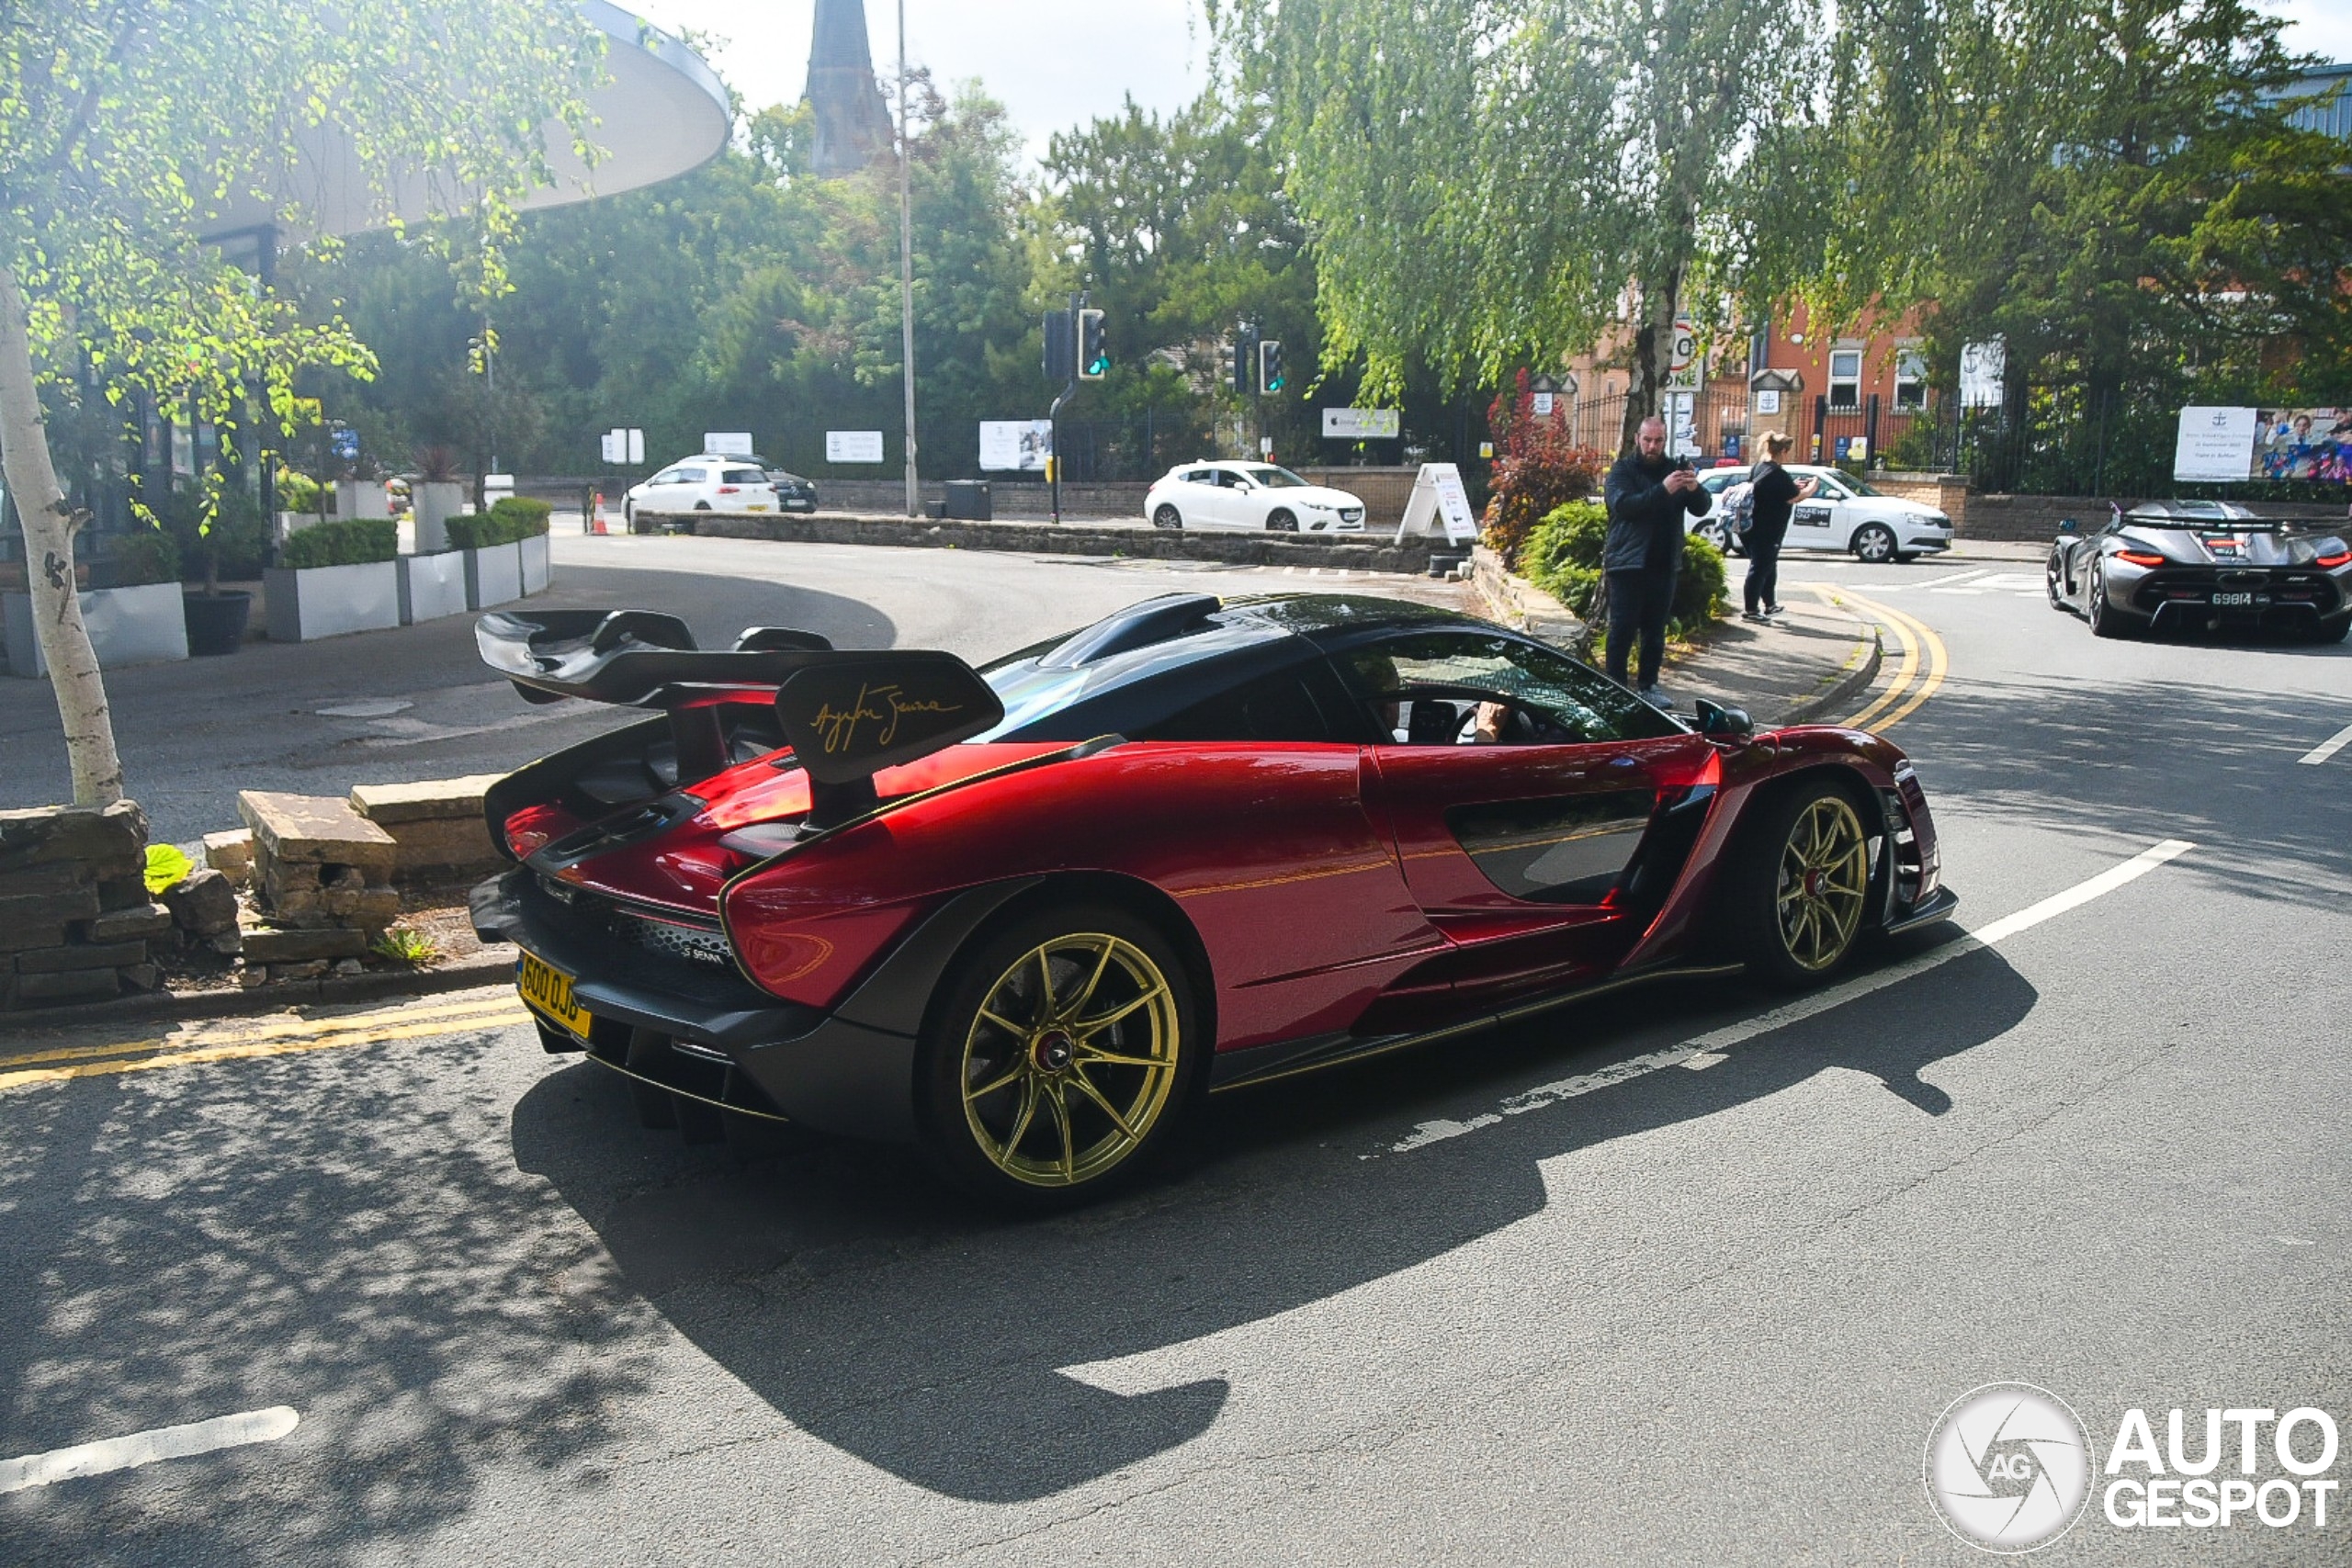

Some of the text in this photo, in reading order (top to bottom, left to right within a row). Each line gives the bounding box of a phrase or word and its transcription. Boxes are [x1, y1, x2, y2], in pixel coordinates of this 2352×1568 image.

[879, 684, 964, 746] Senna
[525, 956, 549, 1002] 600
[693, 949, 724, 964] SENNA
